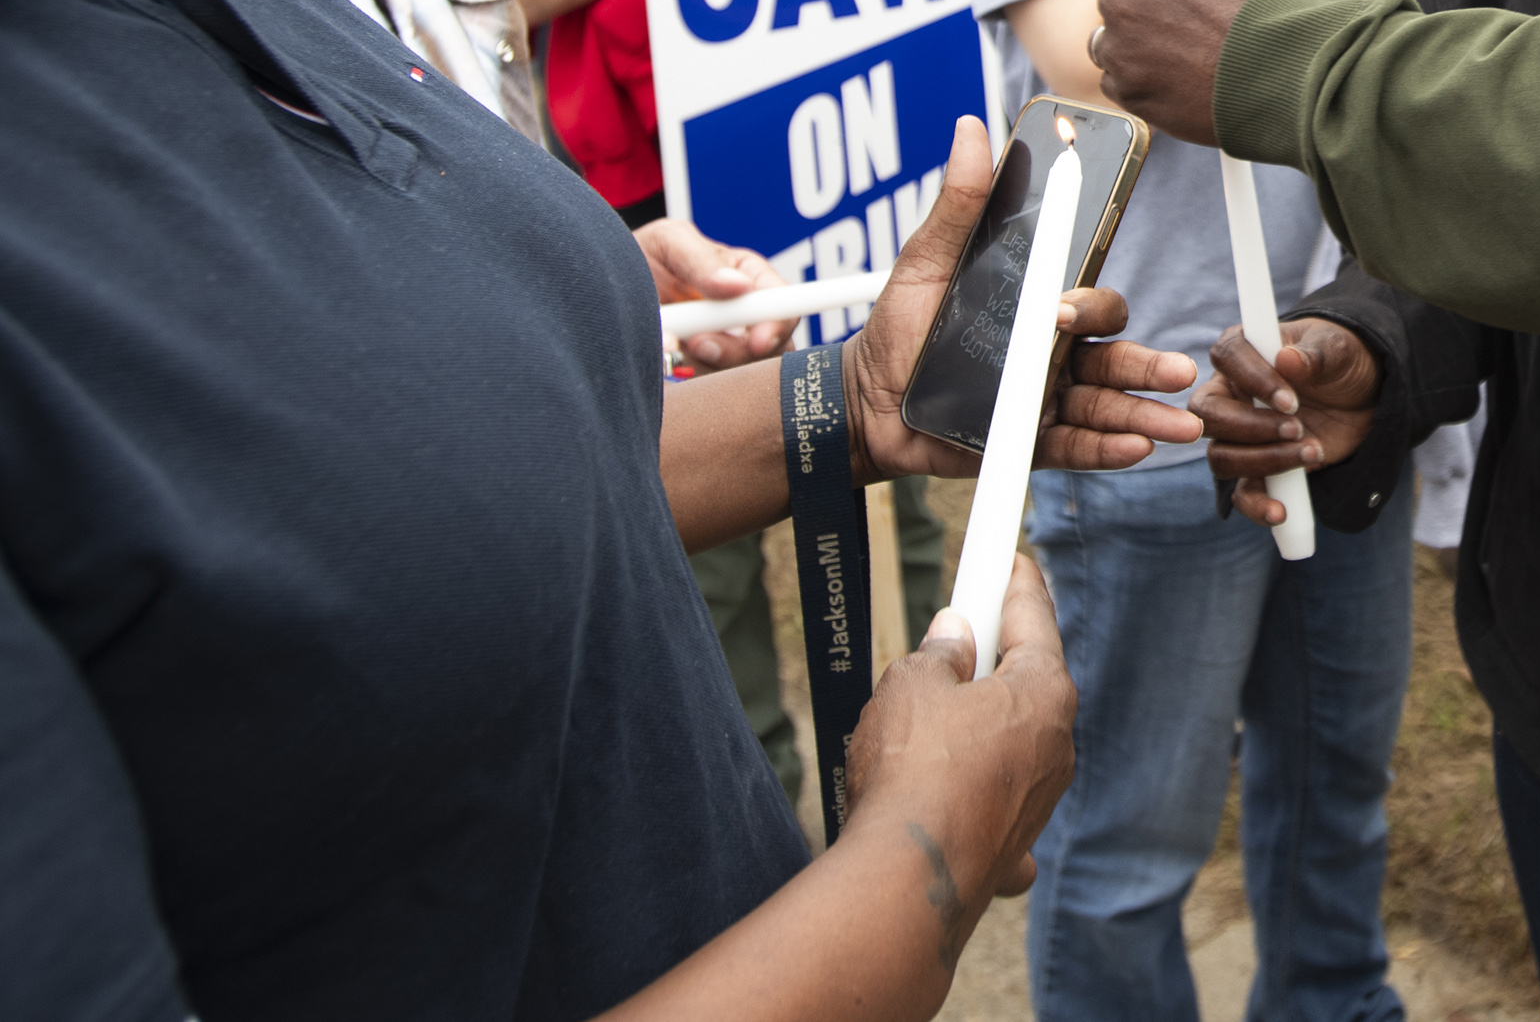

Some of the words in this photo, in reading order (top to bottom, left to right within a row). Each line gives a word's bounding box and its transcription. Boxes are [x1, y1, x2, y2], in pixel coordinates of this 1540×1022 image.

[787, 60, 902, 220] ON
[1002, 229, 1028, 254] LIFE
[1003, 250, 1026, 276] SHO
[986, 293, 1016, 320] WEA
[974, 310, 1011, 344] BORIN
[960, 325, 1008, 368] CLOTHE
[791, 377, 816, 474] experience
[817, 532, 852, 673] #JacksonMI
